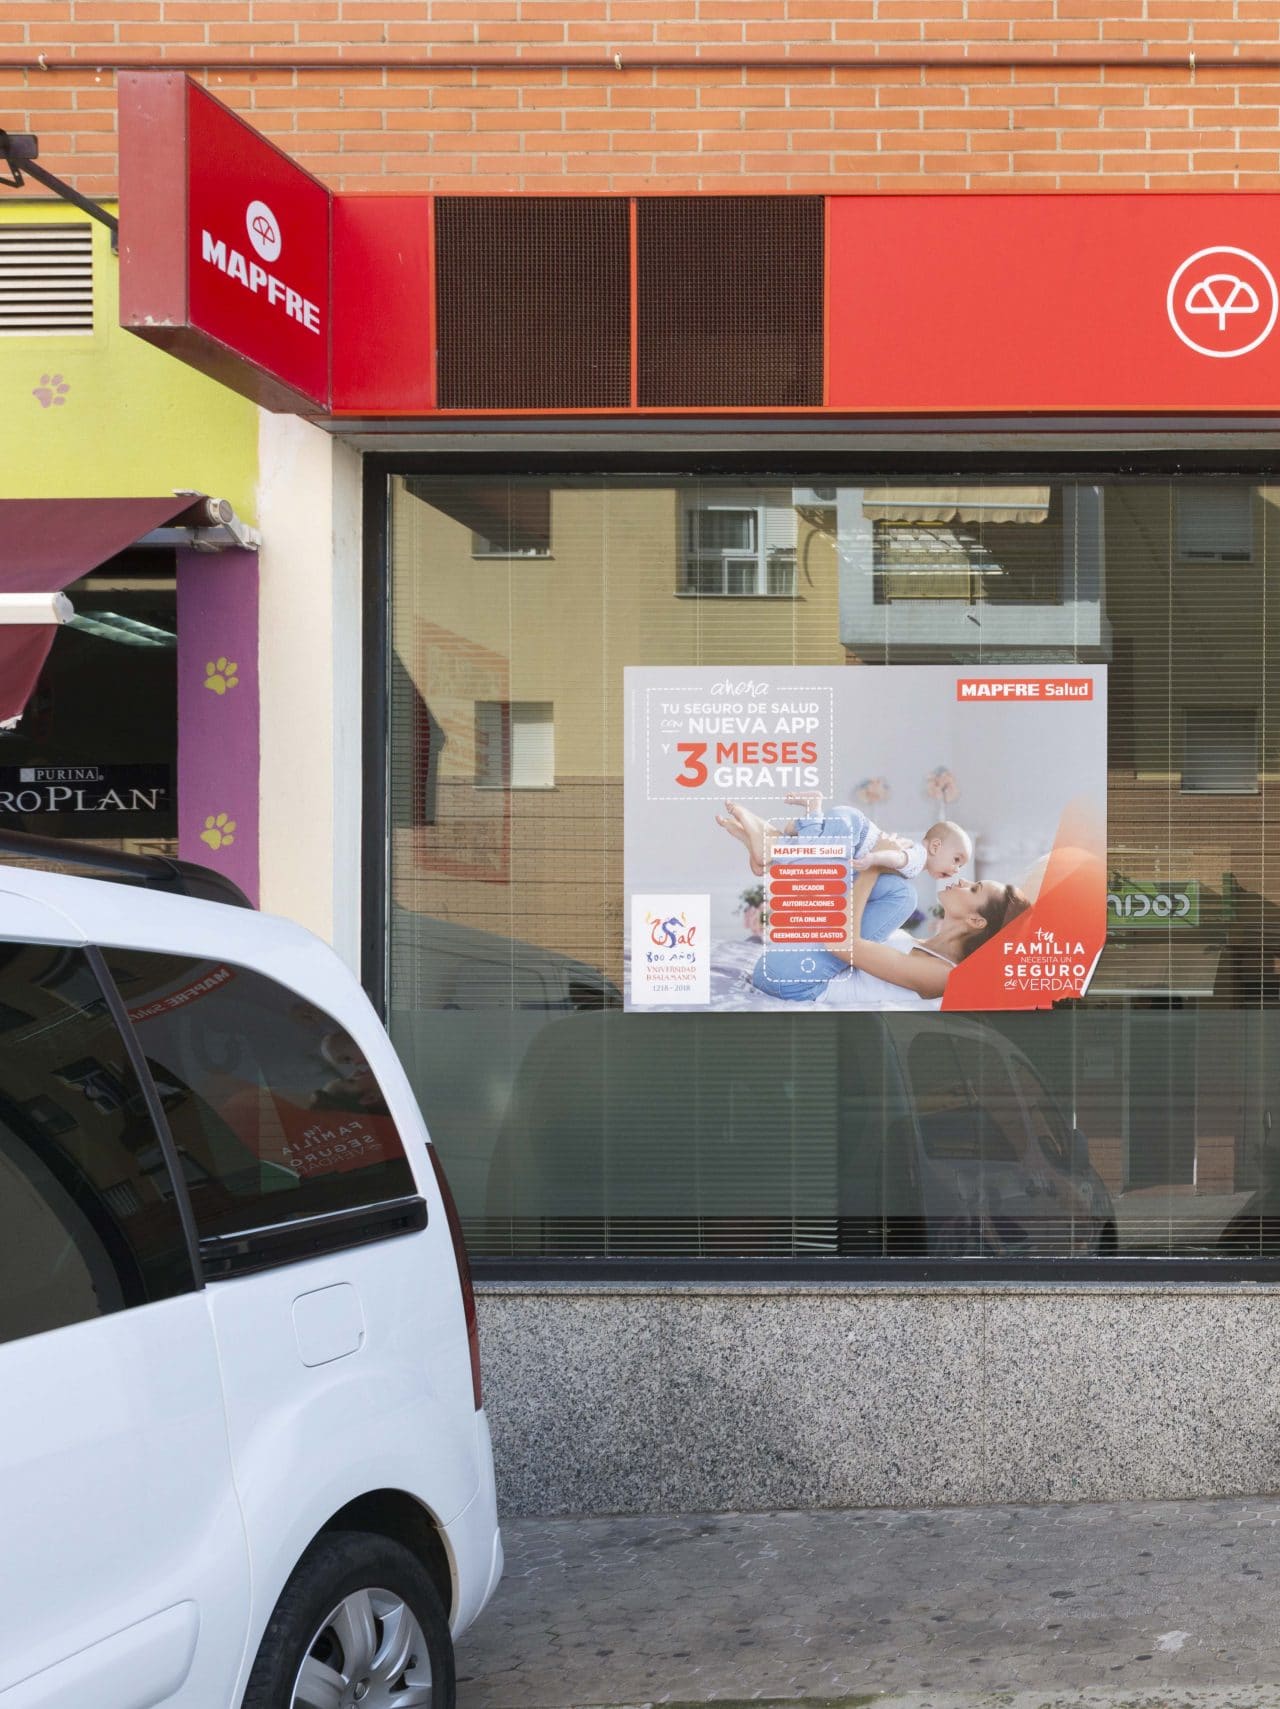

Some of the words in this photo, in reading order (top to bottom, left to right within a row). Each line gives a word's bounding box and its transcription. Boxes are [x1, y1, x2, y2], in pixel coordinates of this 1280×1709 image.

[202, 229, 320, 335] MAPFRE
[710, 678, 770, 698] ahora
[961, 683, 1040, 697] MAPFRE
[1045, 682, 1089, 696] Salud
[661, 703, 680, 714] TU
[684, 703, 743, 714] SEGURO
[748, 703, 767, 714] DE
[771, 703, 819, 714] SALUD
[660, 719, 683, 729] con
[688, 717, 768, 734] NUEVA
[774, 717, 819, 734] APP
[661, 743, 671, 755] Y
[675, 742, 708, 788] 3
[716, 741, 818, 764] MESES
[36, 768, 95, 781] PURINA
[713, 766, 819, 788] GRATIS
[773, 847, 817, 855] MAPFRE
[819, 847, 843, 855] Salud
[1034, 927, 1054, 944] tu
[1003, 942, 1085, 955] FAMILIA
[646, 951, 665, 963] 800
[1004, 964, 1085, 977] SEGURO
[1004, 978, 1018, 989] de
